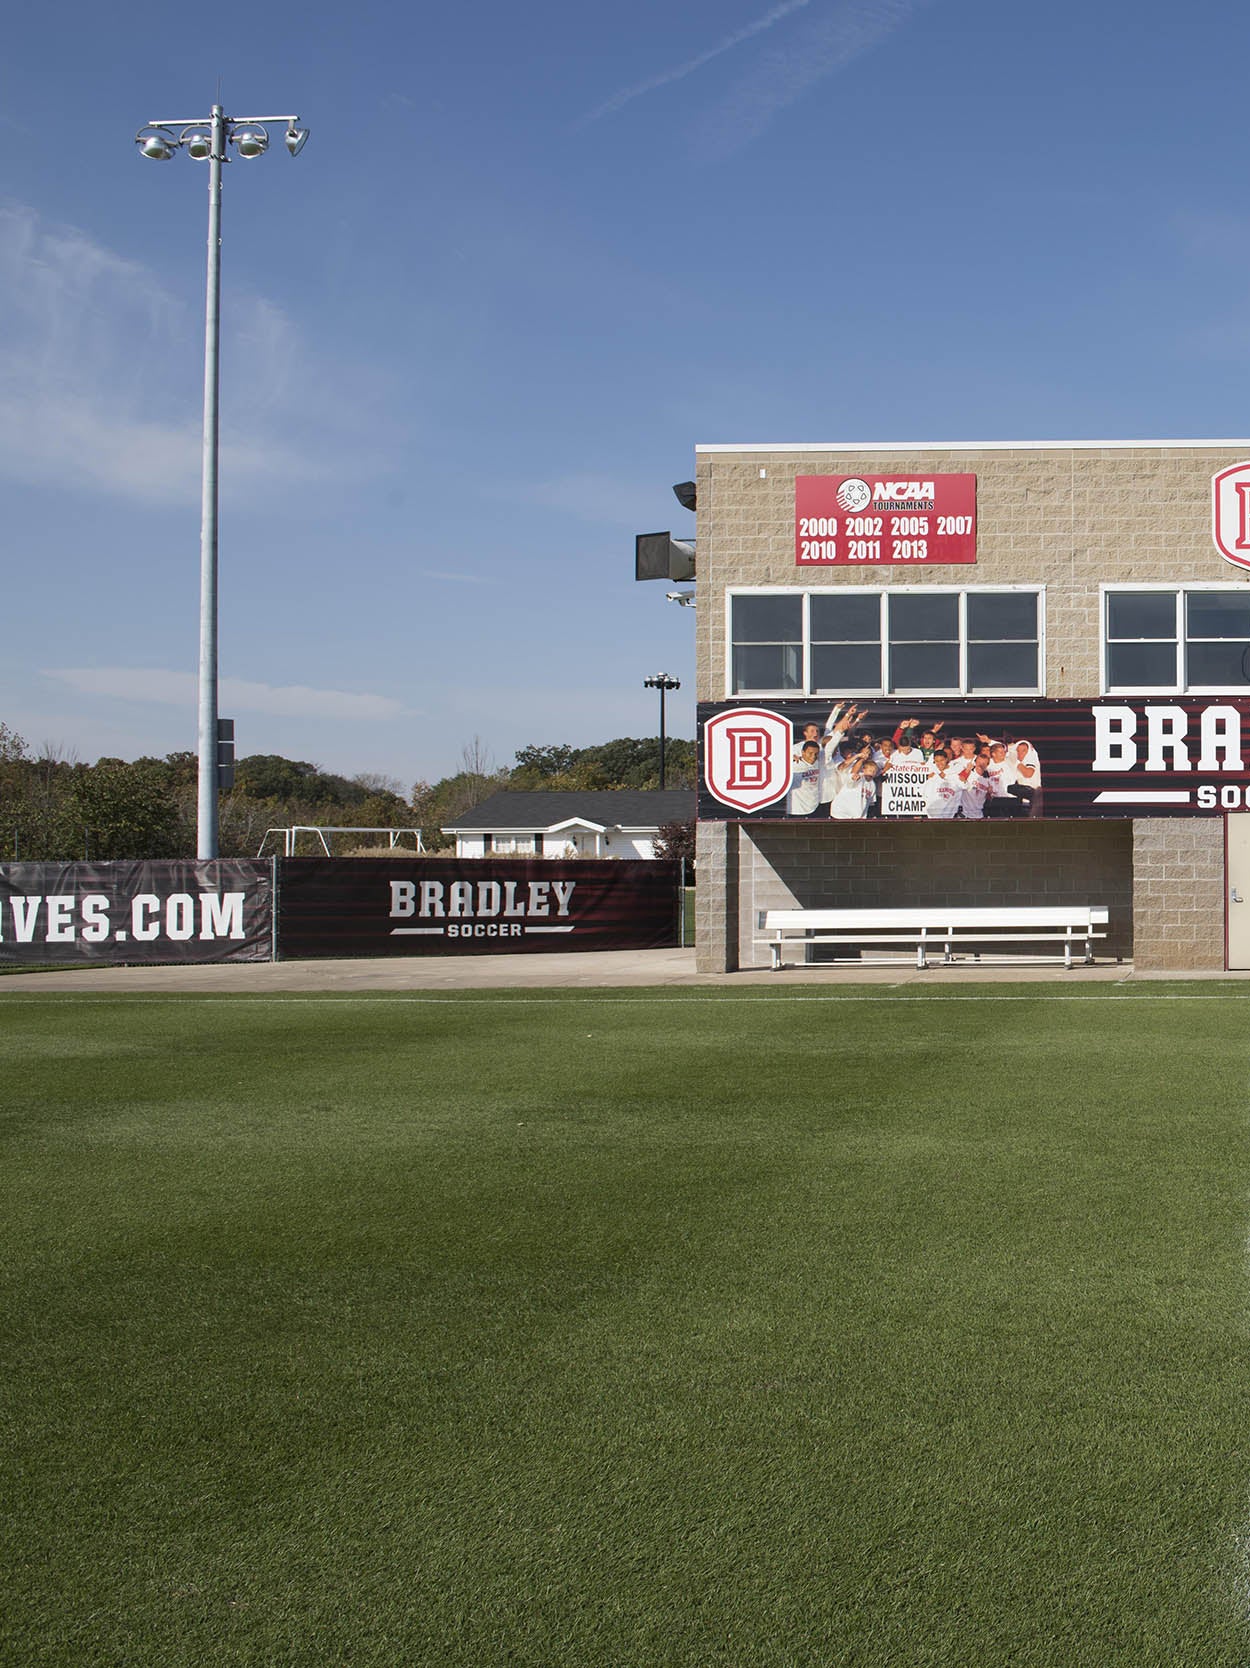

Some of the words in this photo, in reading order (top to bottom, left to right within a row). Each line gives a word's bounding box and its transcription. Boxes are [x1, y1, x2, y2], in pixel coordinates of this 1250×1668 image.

[873, 482, 935, 500] NCAA
[873, 501, 935, 511] TOURNAMENTS
[800, 518, 838, 537] 2000
[845, 517, 883, 536] 2002
[891, 517, 929, 536] 2005
[937, 516, 973, 535] 2007
[801, 540, 837, 560] 2010
[848, 540, 881, 559] 2011
[892, 540, 928, 559] 2013
[726, 728, 772, 790] B
[389, 880, 576, 918] BRADLEY
[0, 892, 246, 943] VES.COM
[447, 924, 522, 938] SOCCER
